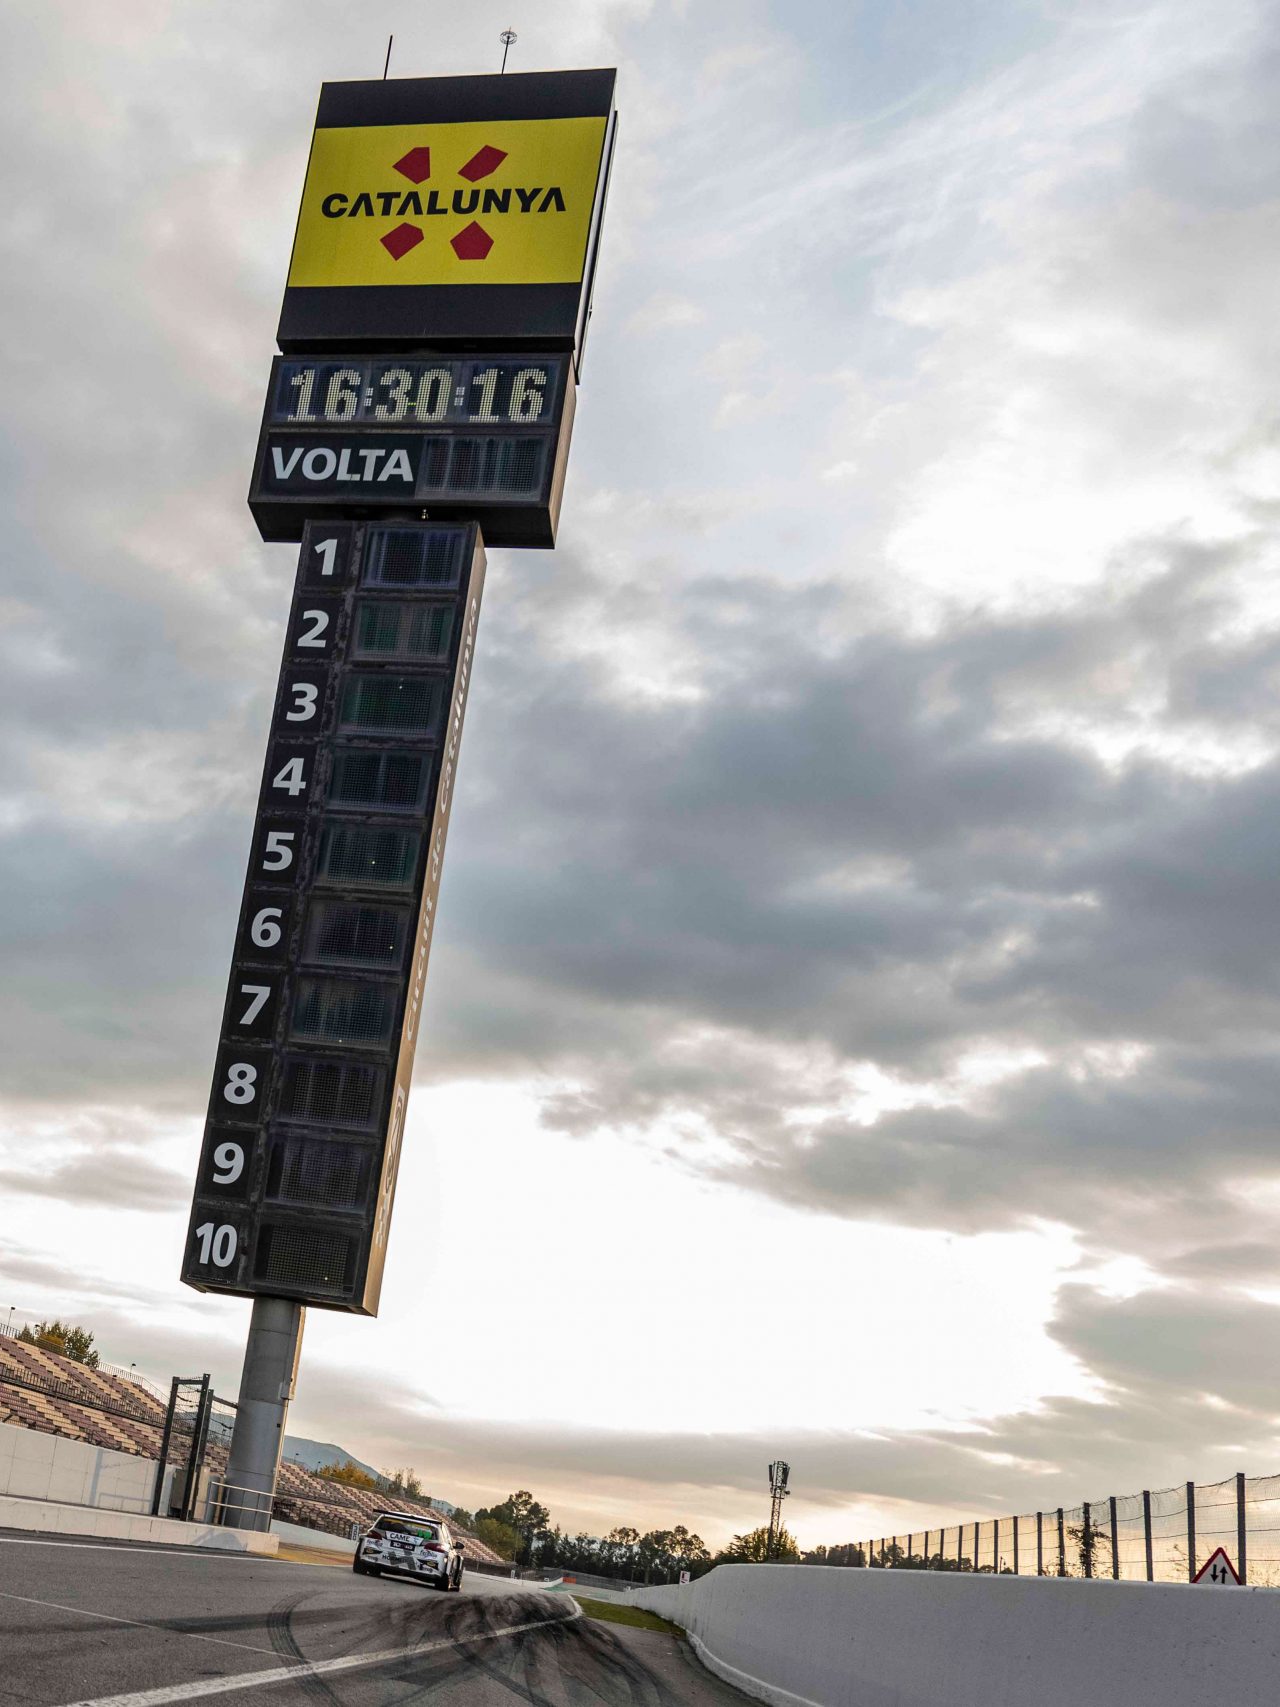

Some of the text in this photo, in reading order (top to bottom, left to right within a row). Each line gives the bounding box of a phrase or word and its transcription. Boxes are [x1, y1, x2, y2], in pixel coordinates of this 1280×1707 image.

[321, 187, 566, 218] CATALUNYA
[287, 367, 547, 424] 16:30:16
[271, 446, 414, 482] VOLTA
[314, 539, 338, 576] 1
[297, 610, 330, 648] 2
[285, 682, 319, 721] 3
[272, 757, 307, 796] 4
[262, 831, 295, 871] 5
[250, 907, 282, 948] 6
[240, 985, 271, 1025] 7
[223, 1063, 258, 1104] 8
[212, 1142, 245, 1184] 9
[195, 1222, 238, 1267] 10
[389, 1532, 411, 1543] CAME
